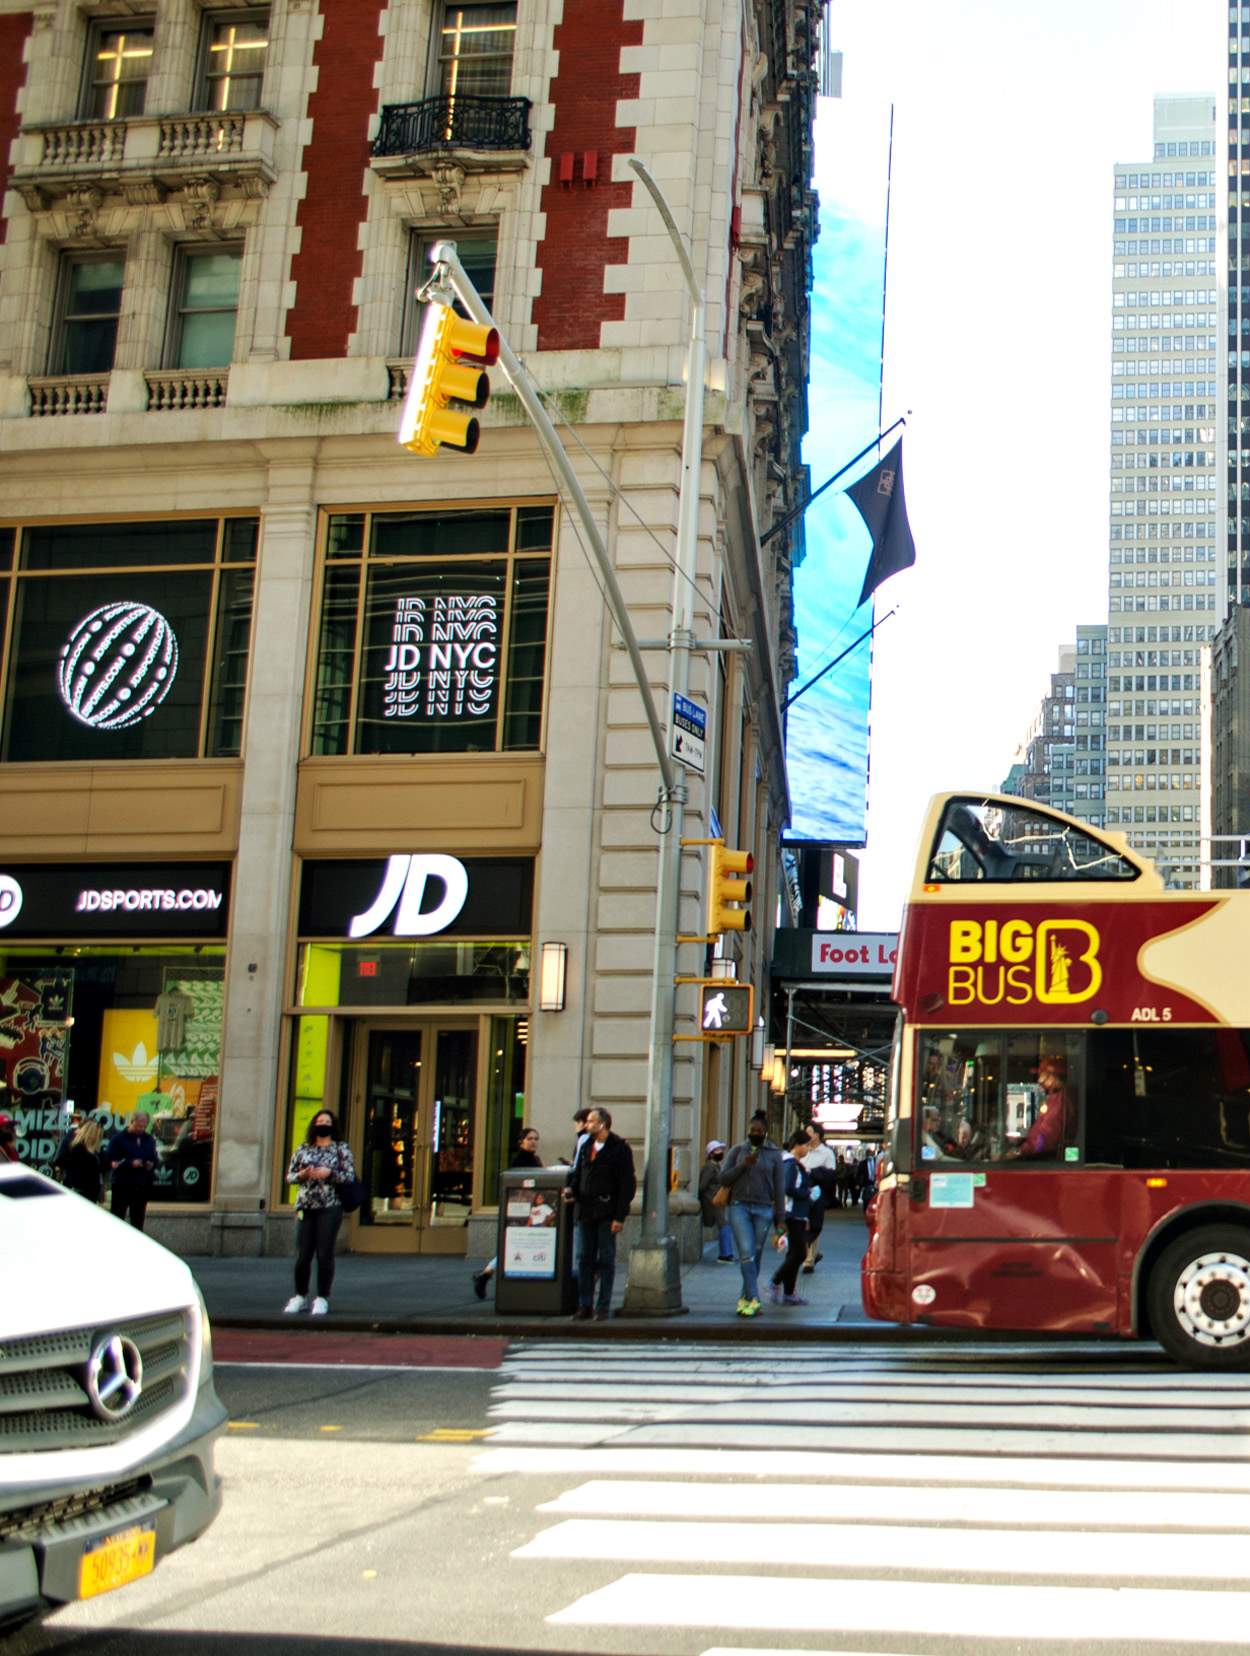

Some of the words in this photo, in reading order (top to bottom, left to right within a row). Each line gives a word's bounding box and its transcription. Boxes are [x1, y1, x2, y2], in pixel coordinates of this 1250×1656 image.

[385, 644, 421, 671] JD
[429, 642, 496, 669] NYC
[77, 890, 222, 911] JDSPORTS.COM
[350, 854, 468, 938] JD
[820, 944, 869, 963] Foot
[949, 919, 1034, 964] BIG
[948, 965, 1032, 1005] BUS
[1131, 1008, 1159, 1022] ADL
[1162, 1008, 1172, 1022] 5
